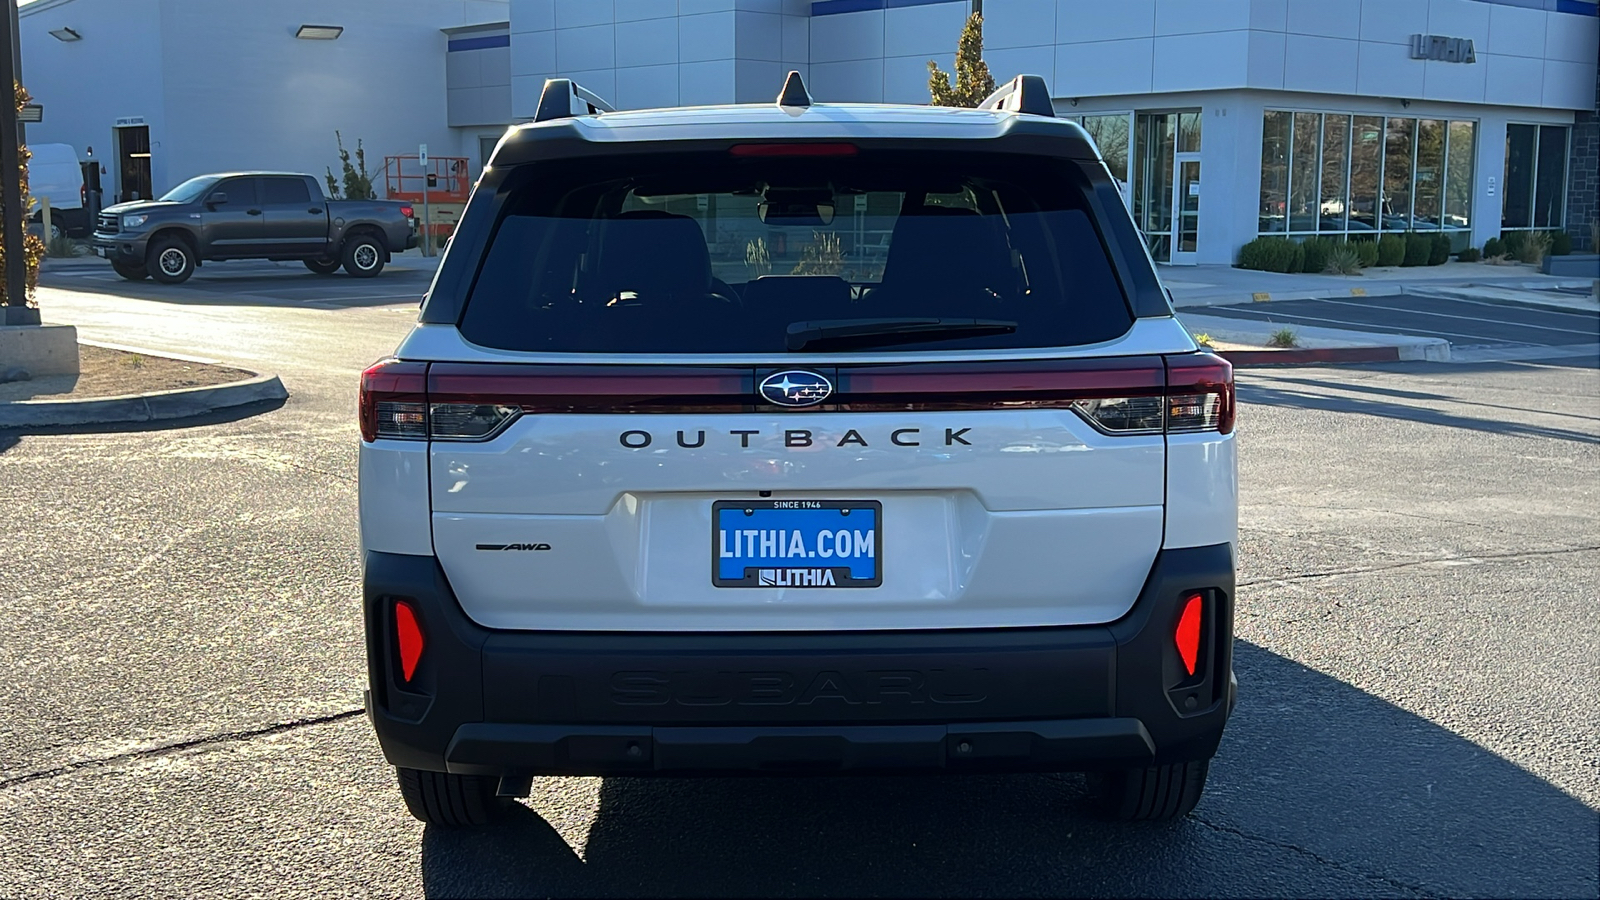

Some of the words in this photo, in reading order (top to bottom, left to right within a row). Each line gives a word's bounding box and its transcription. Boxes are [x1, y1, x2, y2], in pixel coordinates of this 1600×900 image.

[1410, 33, 1476, 64] LITHIA
[619, 428, 972, 449] OUTBACK
[773, 501, 799, 509] SINCE
[801, 501, 821, 509] 1946
[504, 543, 552, 551] AWD
[719, 529, 875, 558] LITHIA.COM
[776, 568, 836, 586] LITHIA
[610, 667, 989, 706] SUBARU
